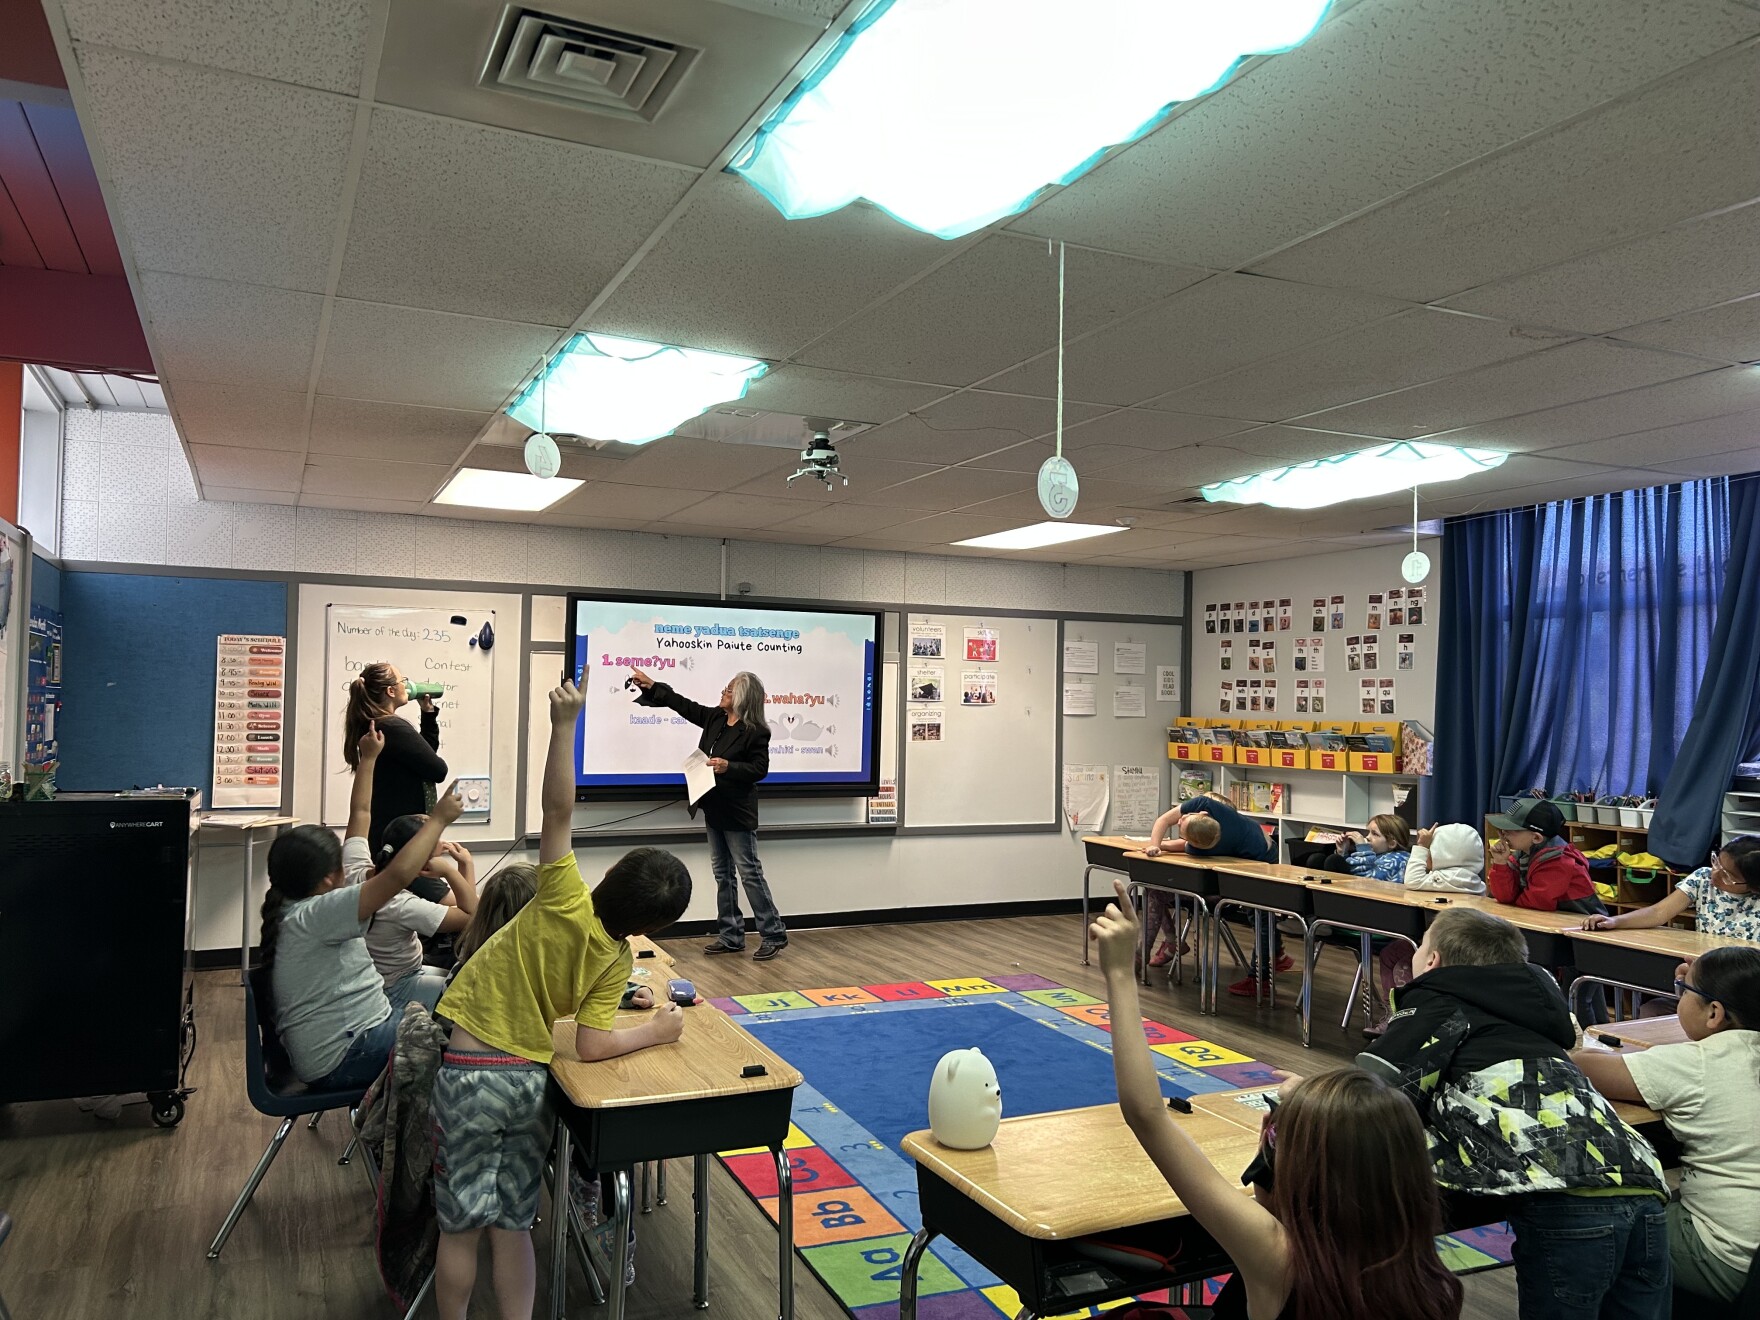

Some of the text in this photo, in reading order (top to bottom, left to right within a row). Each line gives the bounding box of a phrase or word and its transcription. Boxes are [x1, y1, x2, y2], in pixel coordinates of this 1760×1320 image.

[337, 621, 451, 643] Number of the day: 235
[654, 623, 800, 641] neme yadua tsatsenge
[656, 637, 802, 654] Yahooskin Paiute Counting
[424, 657, 471, 671] Contest
[941, 983, 999, 994] Mm
[822, 993, 860, 1003] Kk
[1178, 1045, 1225, 1062] Qq
[811, 1200, 866, 1229] Bb
